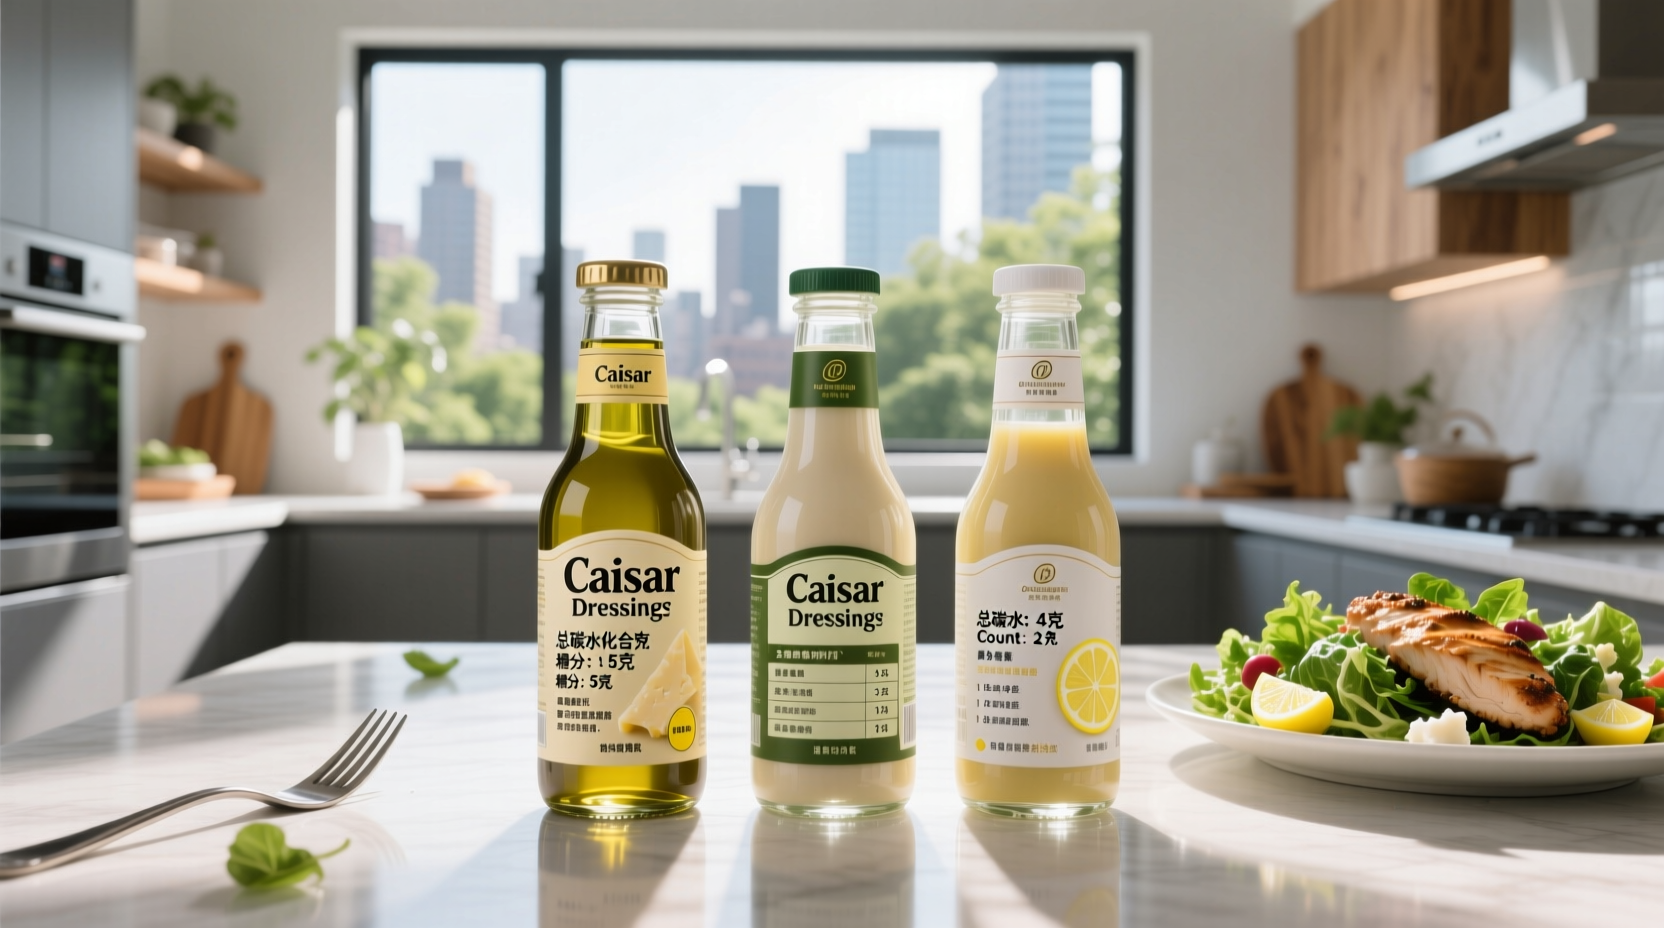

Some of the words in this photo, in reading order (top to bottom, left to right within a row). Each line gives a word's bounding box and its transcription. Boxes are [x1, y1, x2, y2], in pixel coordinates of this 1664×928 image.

[595, 364, 652, 383] Caisar
[564, 556, 681, 594] Caisar
[786, 572, 884, 604] Caisar
[572, 597, 672, 623] Dressings
[788, 608, 884, 633] Dressings
